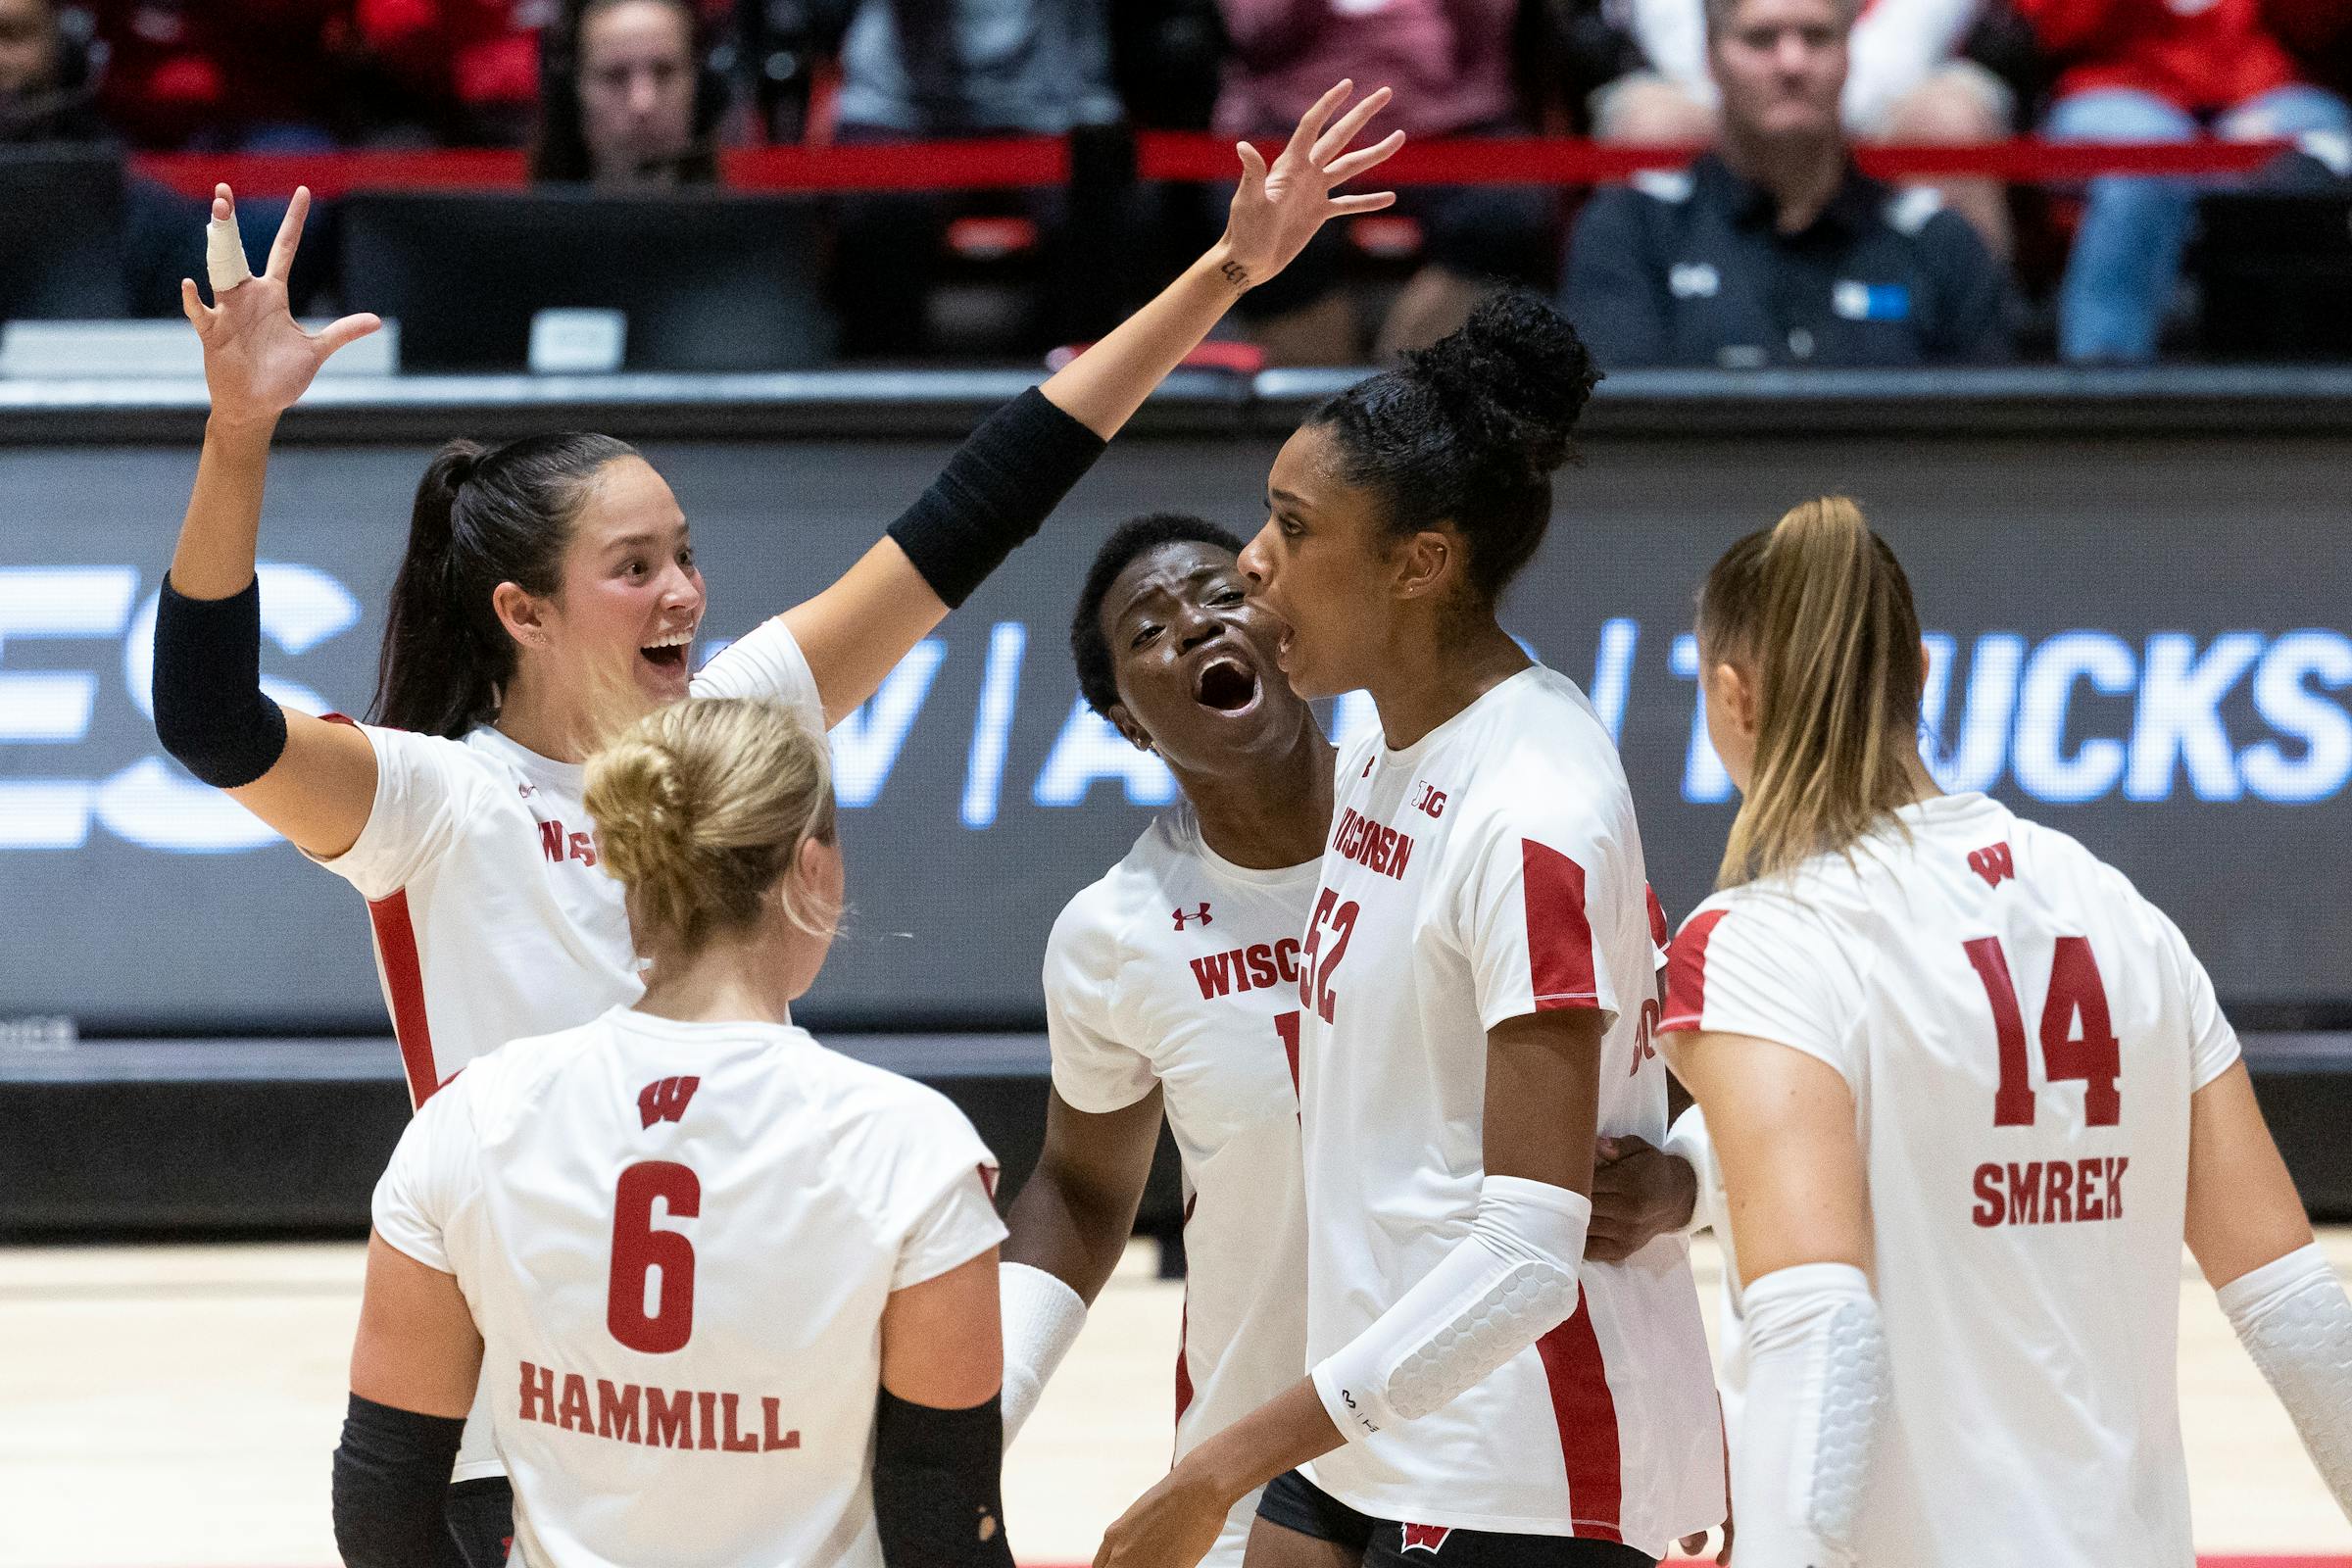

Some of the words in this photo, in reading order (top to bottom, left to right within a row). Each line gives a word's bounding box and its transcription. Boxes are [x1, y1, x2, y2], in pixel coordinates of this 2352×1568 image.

[1667, 627, 2352, 806] TUCKS
[1189, 937, 1301, 1001] WISC
[1299, 887, 1360, 1025] 52
[1962, 936, 2121, 1127] 14
[606, 1159, 702, 1355] 6
[1972, 1156, 2130, 1228] SMREK
[518, 1359, 801, 1452] HAMMILL
